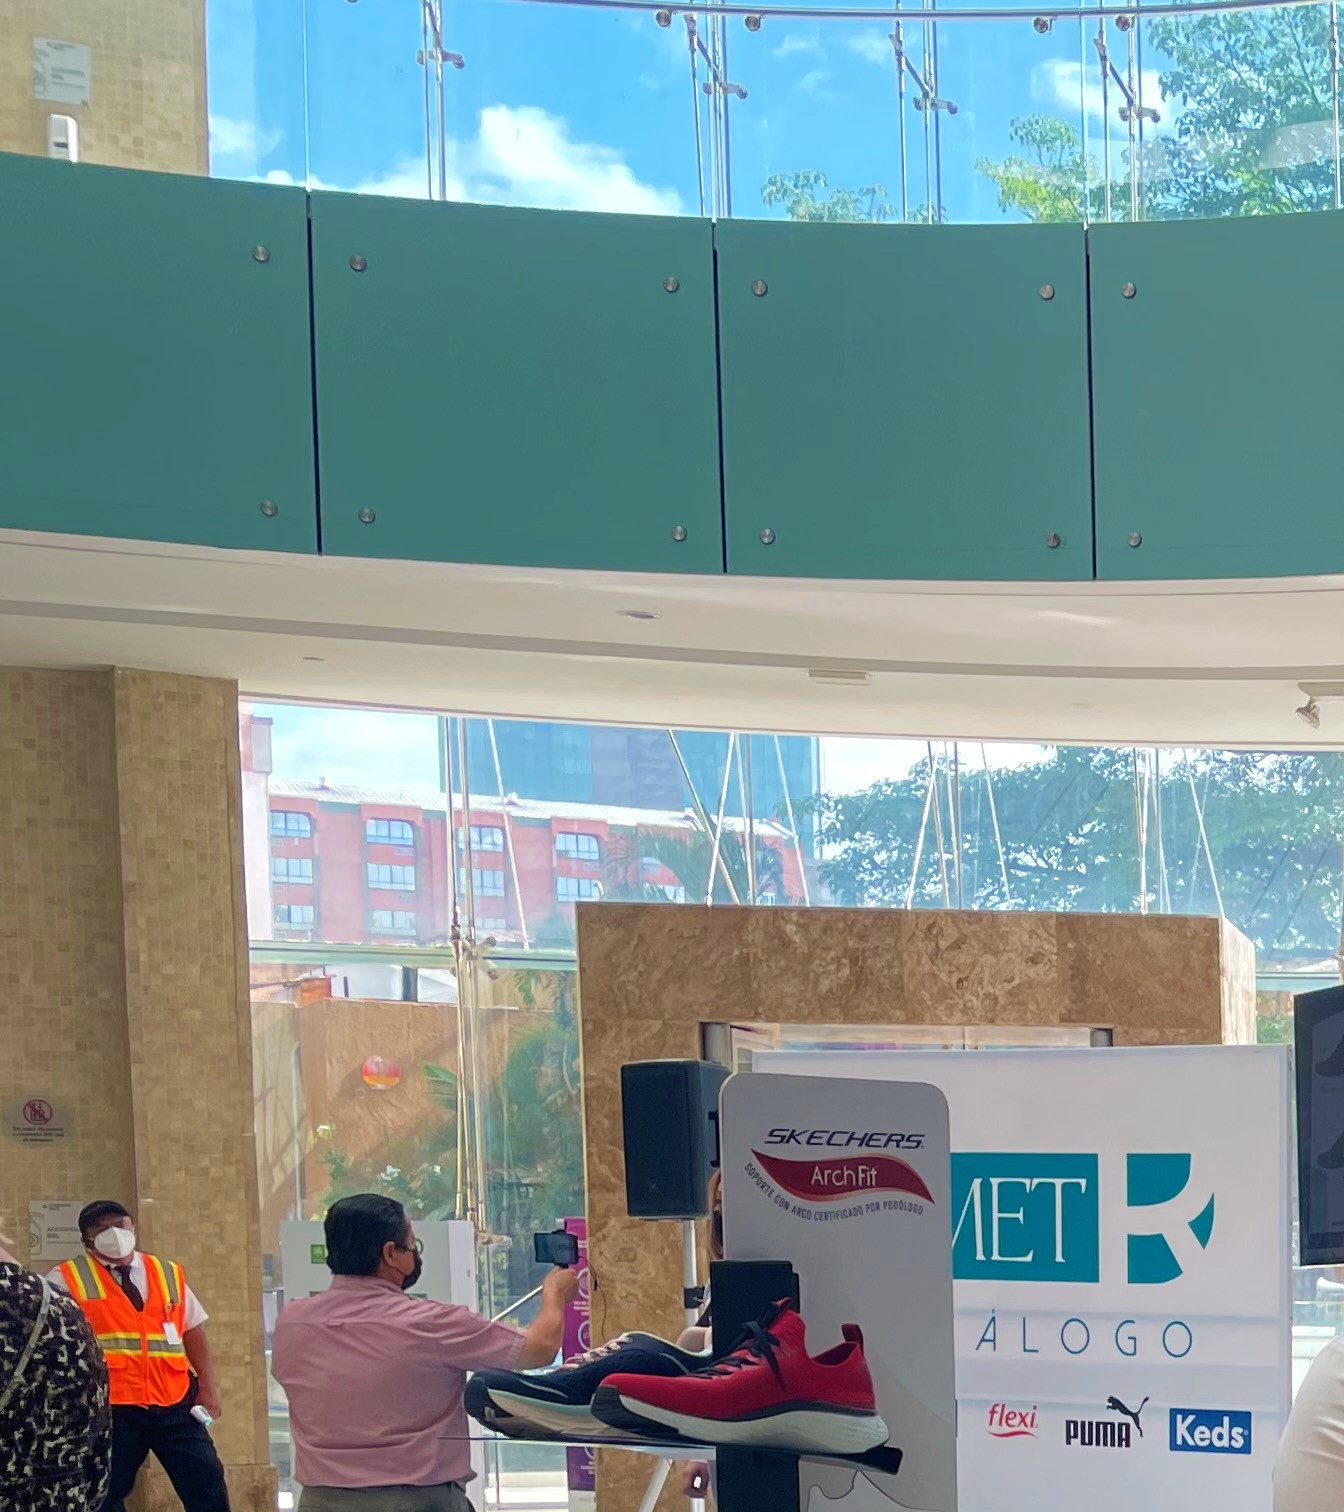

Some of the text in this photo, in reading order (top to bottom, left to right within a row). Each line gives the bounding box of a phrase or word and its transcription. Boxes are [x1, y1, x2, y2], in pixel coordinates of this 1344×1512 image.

[764, 1128, 926, 1149] SKECHERS
[744, 1162, 774, 1199] SOPORTE
[774, 1194, 790, 1211] CON
[791, 1205, 812, 1221] ARCO
[813, 1205, 865, 1222] CERTIFICADO
[865, 1201, 881, 1214] POR
[988, 1402, 1038, 1429] flexi
[1065, 1419, 1131, 1448] PUMA
[1175, 1414, 1245, 1449] Keds
